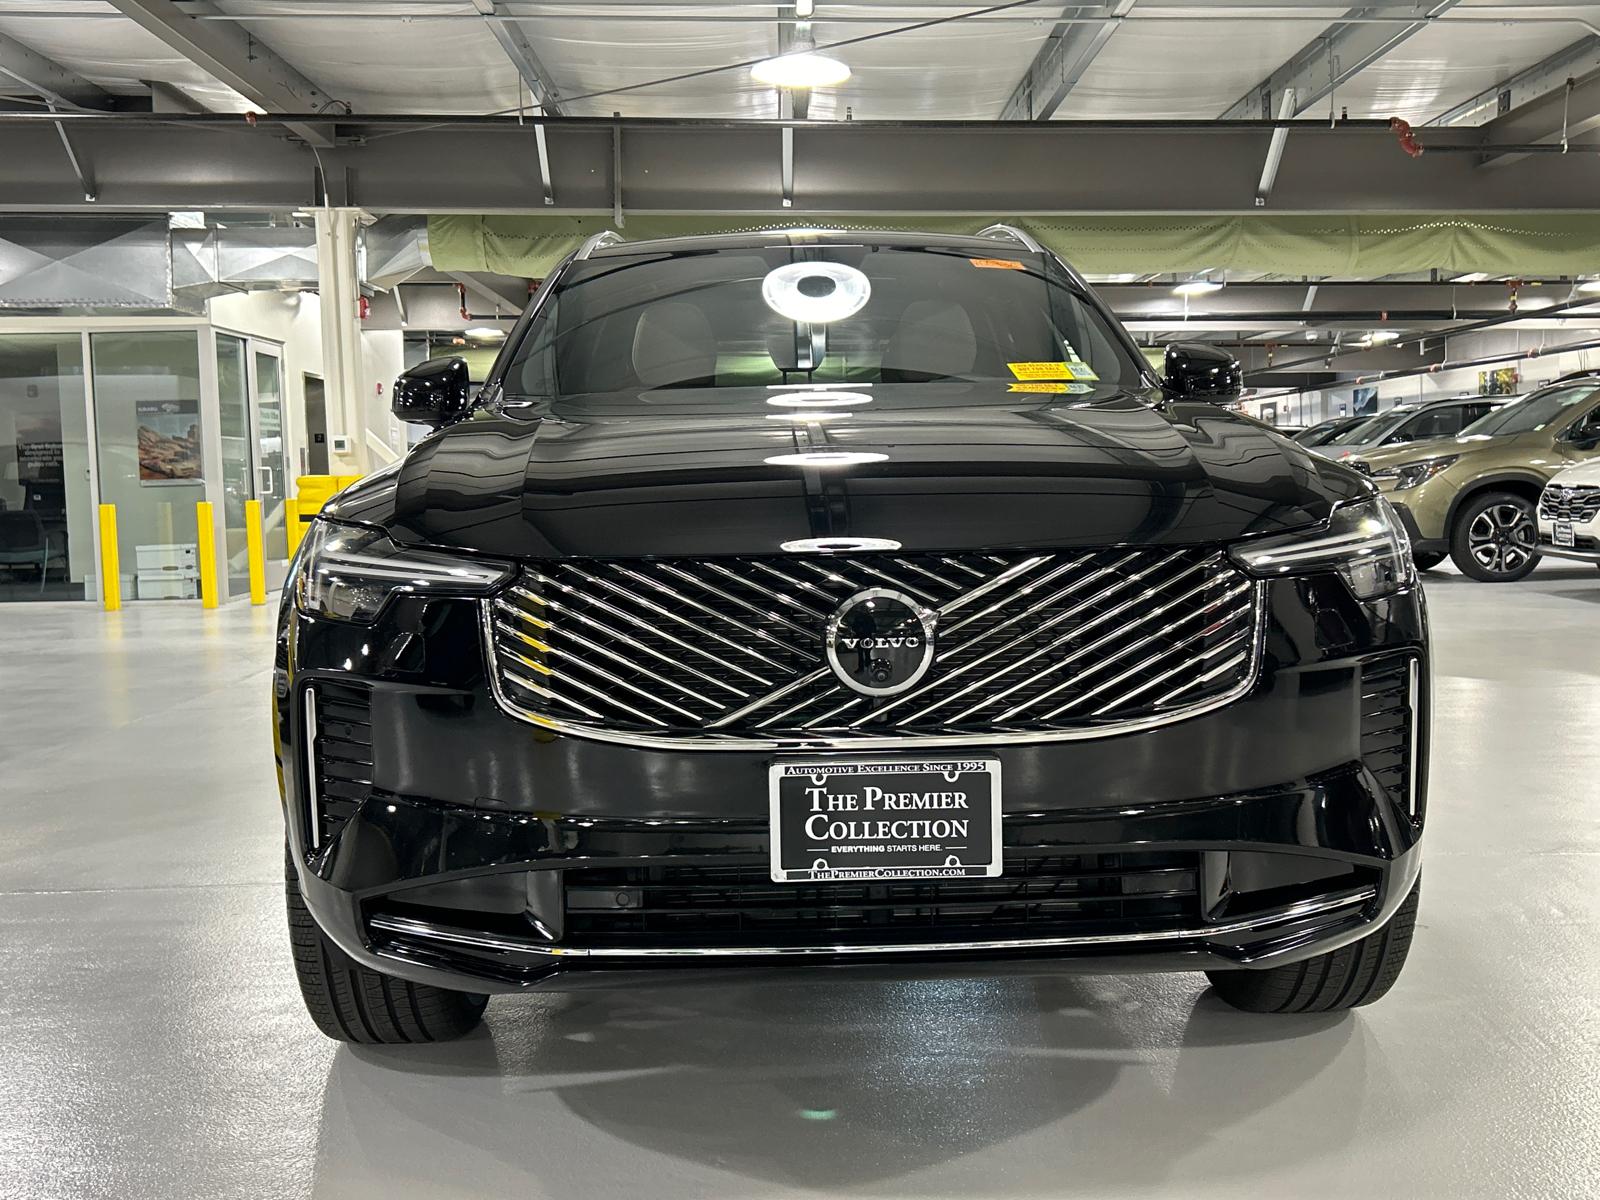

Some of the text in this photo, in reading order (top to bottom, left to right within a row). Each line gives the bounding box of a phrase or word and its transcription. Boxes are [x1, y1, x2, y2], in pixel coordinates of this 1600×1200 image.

[841, 637, 919, 649] VOLVO
[857, 764, 921, 773] EXCELLENCE
[922, 763, 954, 772] SINCE
[956, 762, 985, 771] 1995
[805, 786, 969, 812] THE PREMIER
[805, 814, 969, 840] COLLECTION
[831, 844, 943, 853] EVERYTHING STARTS HERE.
